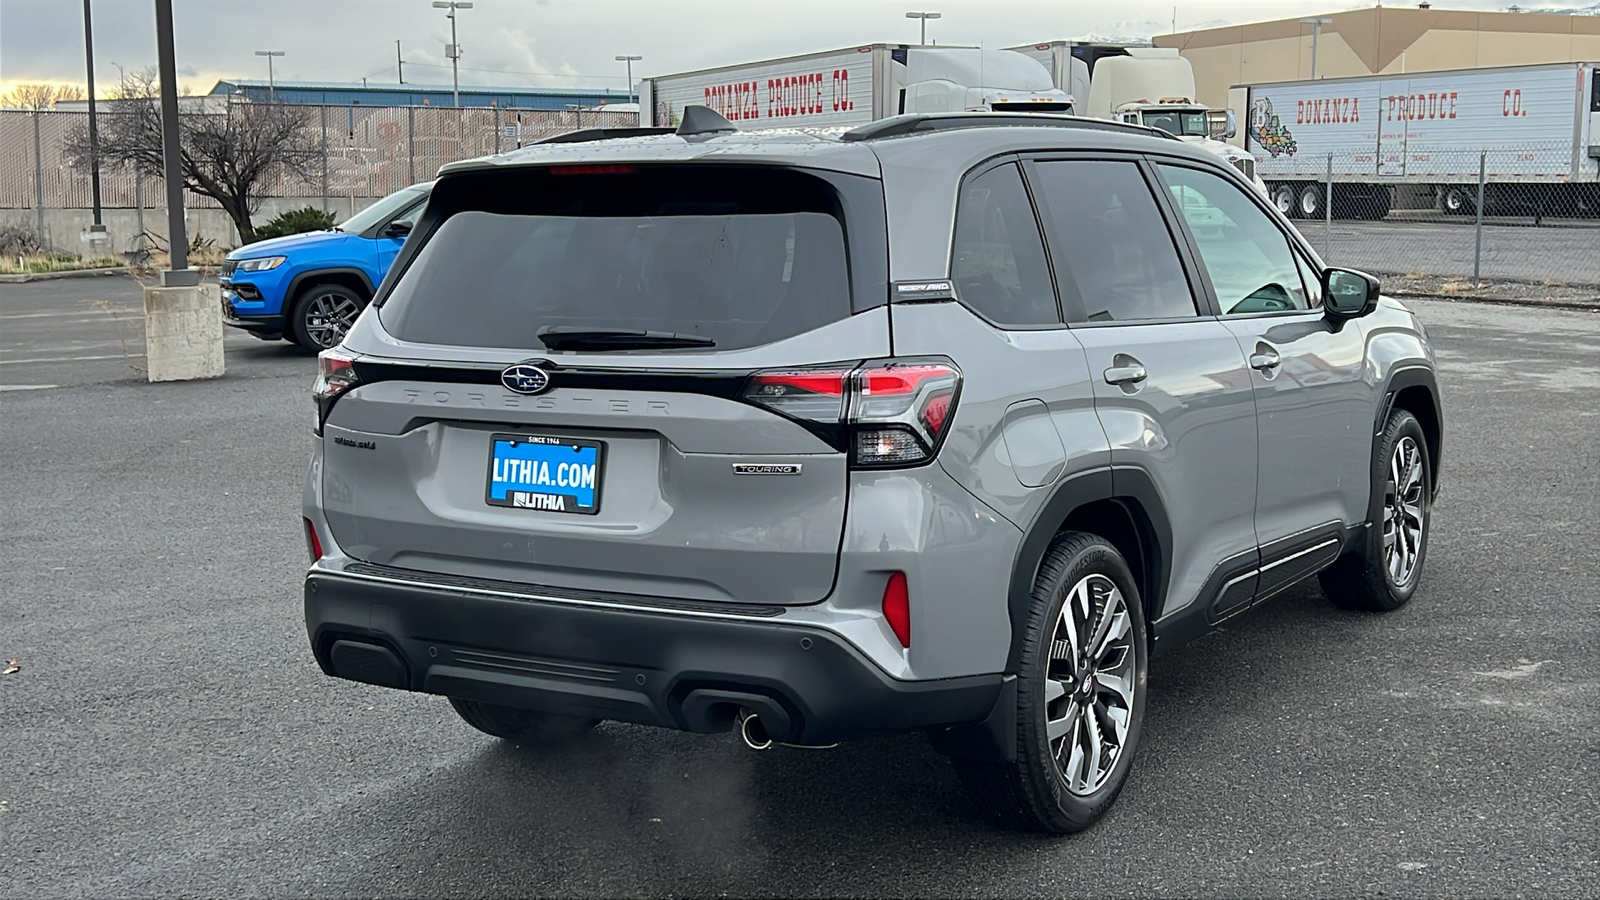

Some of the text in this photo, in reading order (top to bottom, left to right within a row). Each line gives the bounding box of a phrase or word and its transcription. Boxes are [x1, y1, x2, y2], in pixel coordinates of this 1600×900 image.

[768, 73, 823, 118] PRODUCE
[833, 69, 853, 111] CO.
[1297, 88, 1527, 124] BONANZA PRODUCE CO.
[403, 388, 672, 415] FORESTER
[528, 436, 560, 445] SINCE 1946
[492, 457, 596, 489] LITHIA.COM
[739, 465, 793, 473] TOURING
[525, 492, 565, 511] LITHIA
